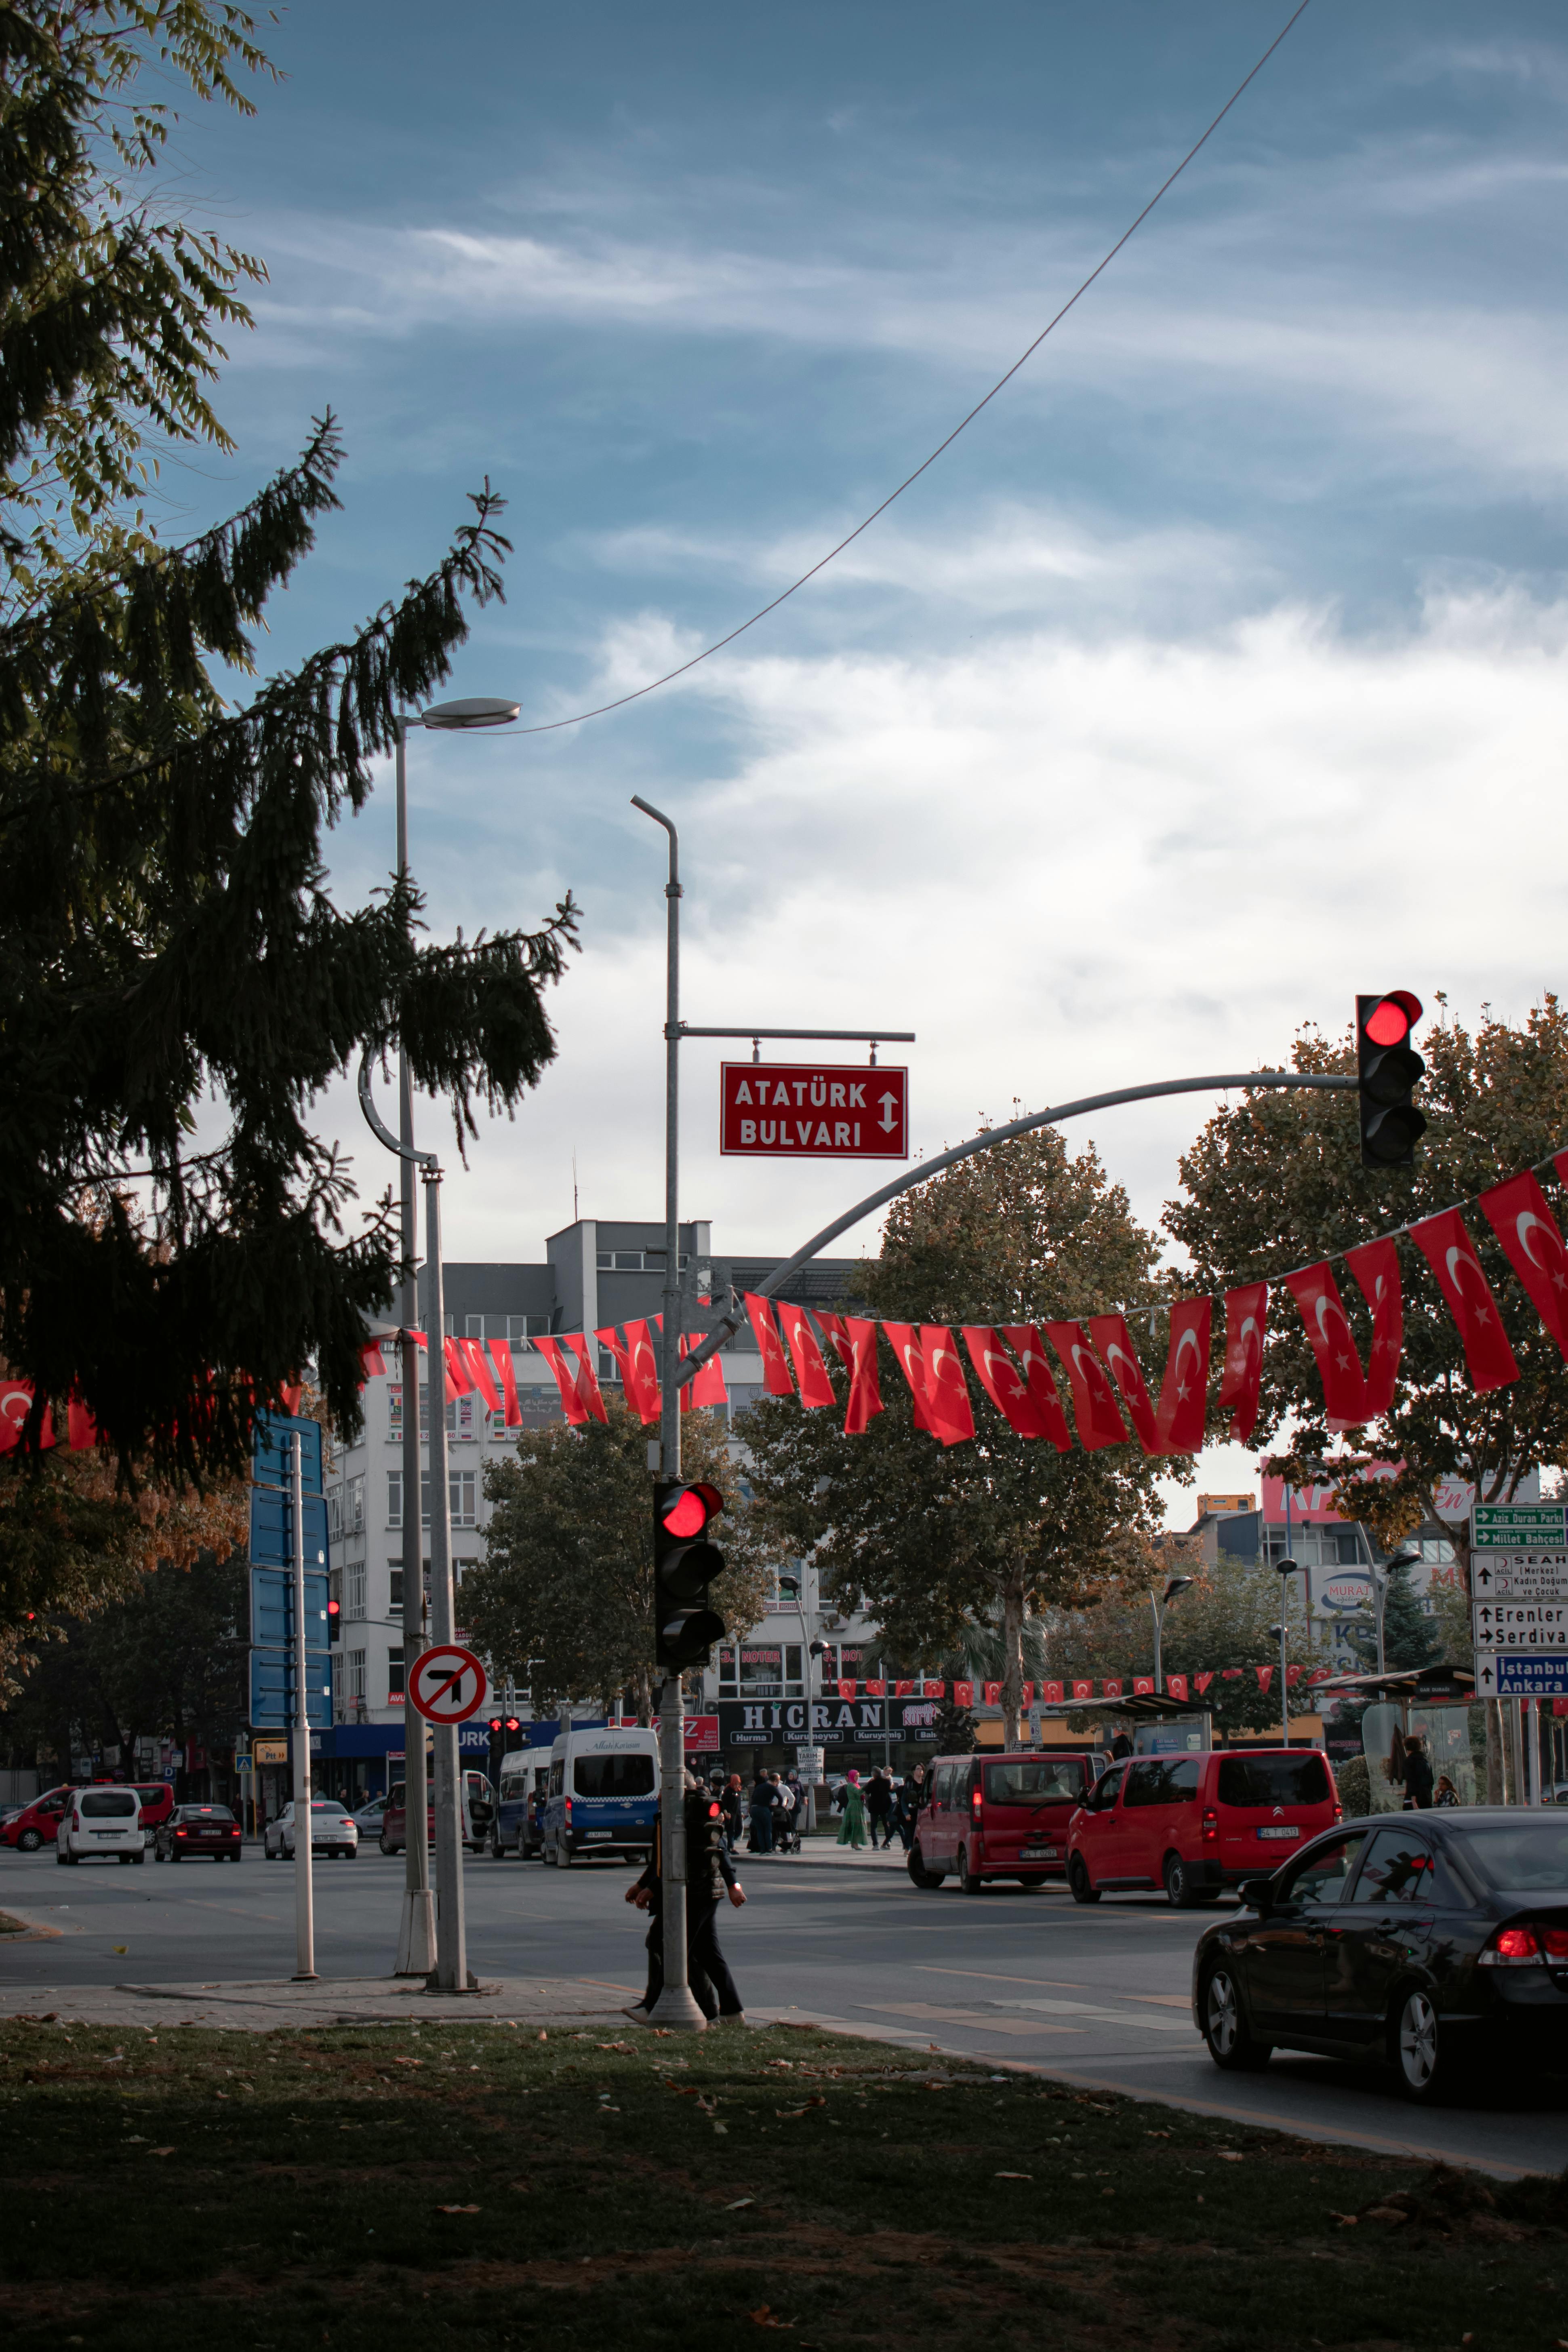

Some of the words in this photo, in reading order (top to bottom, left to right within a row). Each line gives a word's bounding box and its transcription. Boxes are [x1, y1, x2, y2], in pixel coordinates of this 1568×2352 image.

[735, 1076, 867, 1108] ATATÜRK
[741, 1120, 860, 1146] BULVARI
[1492, 1513, 1509, 1523] Aziz
[1513, 1514, 1536, 1523] Duran
[1541, 1513, 1562, 1523] Parkı
[1492, 1534, 1521, 1543] Millet
[1526, 1534, 1563, 1545] Bahçesi
[1514, 1556, 1566, 1564] SEAH
[1514, 1577, 1537, 1585] Kadın
[1541, 1577, 1568, 1586] Doğum
[1329, 1585, 1370, 1596] MURAT
[1535, 1588, 1560, 1596] Çocuk
[1495, 1607, 1563, 1622] Erenler
[1496, 1628, 1566, 1644] Serdiva
[720, 1651, 734, 1662] 3.
[742, 1651, 780, 1662] NOTER
[823, 1650, 836, 1661] 3.
[841, 1649, 863, 1661] NOT
[1500, 1678, 1563, 1692] Ankara
[907, 1703, 930, 1712] organik
[903, 1710, 932, 1726] kuru
[586, 1740, 613, 1751] Allah
[265, 1752, 276, 1760] Ptt
[165, 1767, 173, 1777] D
